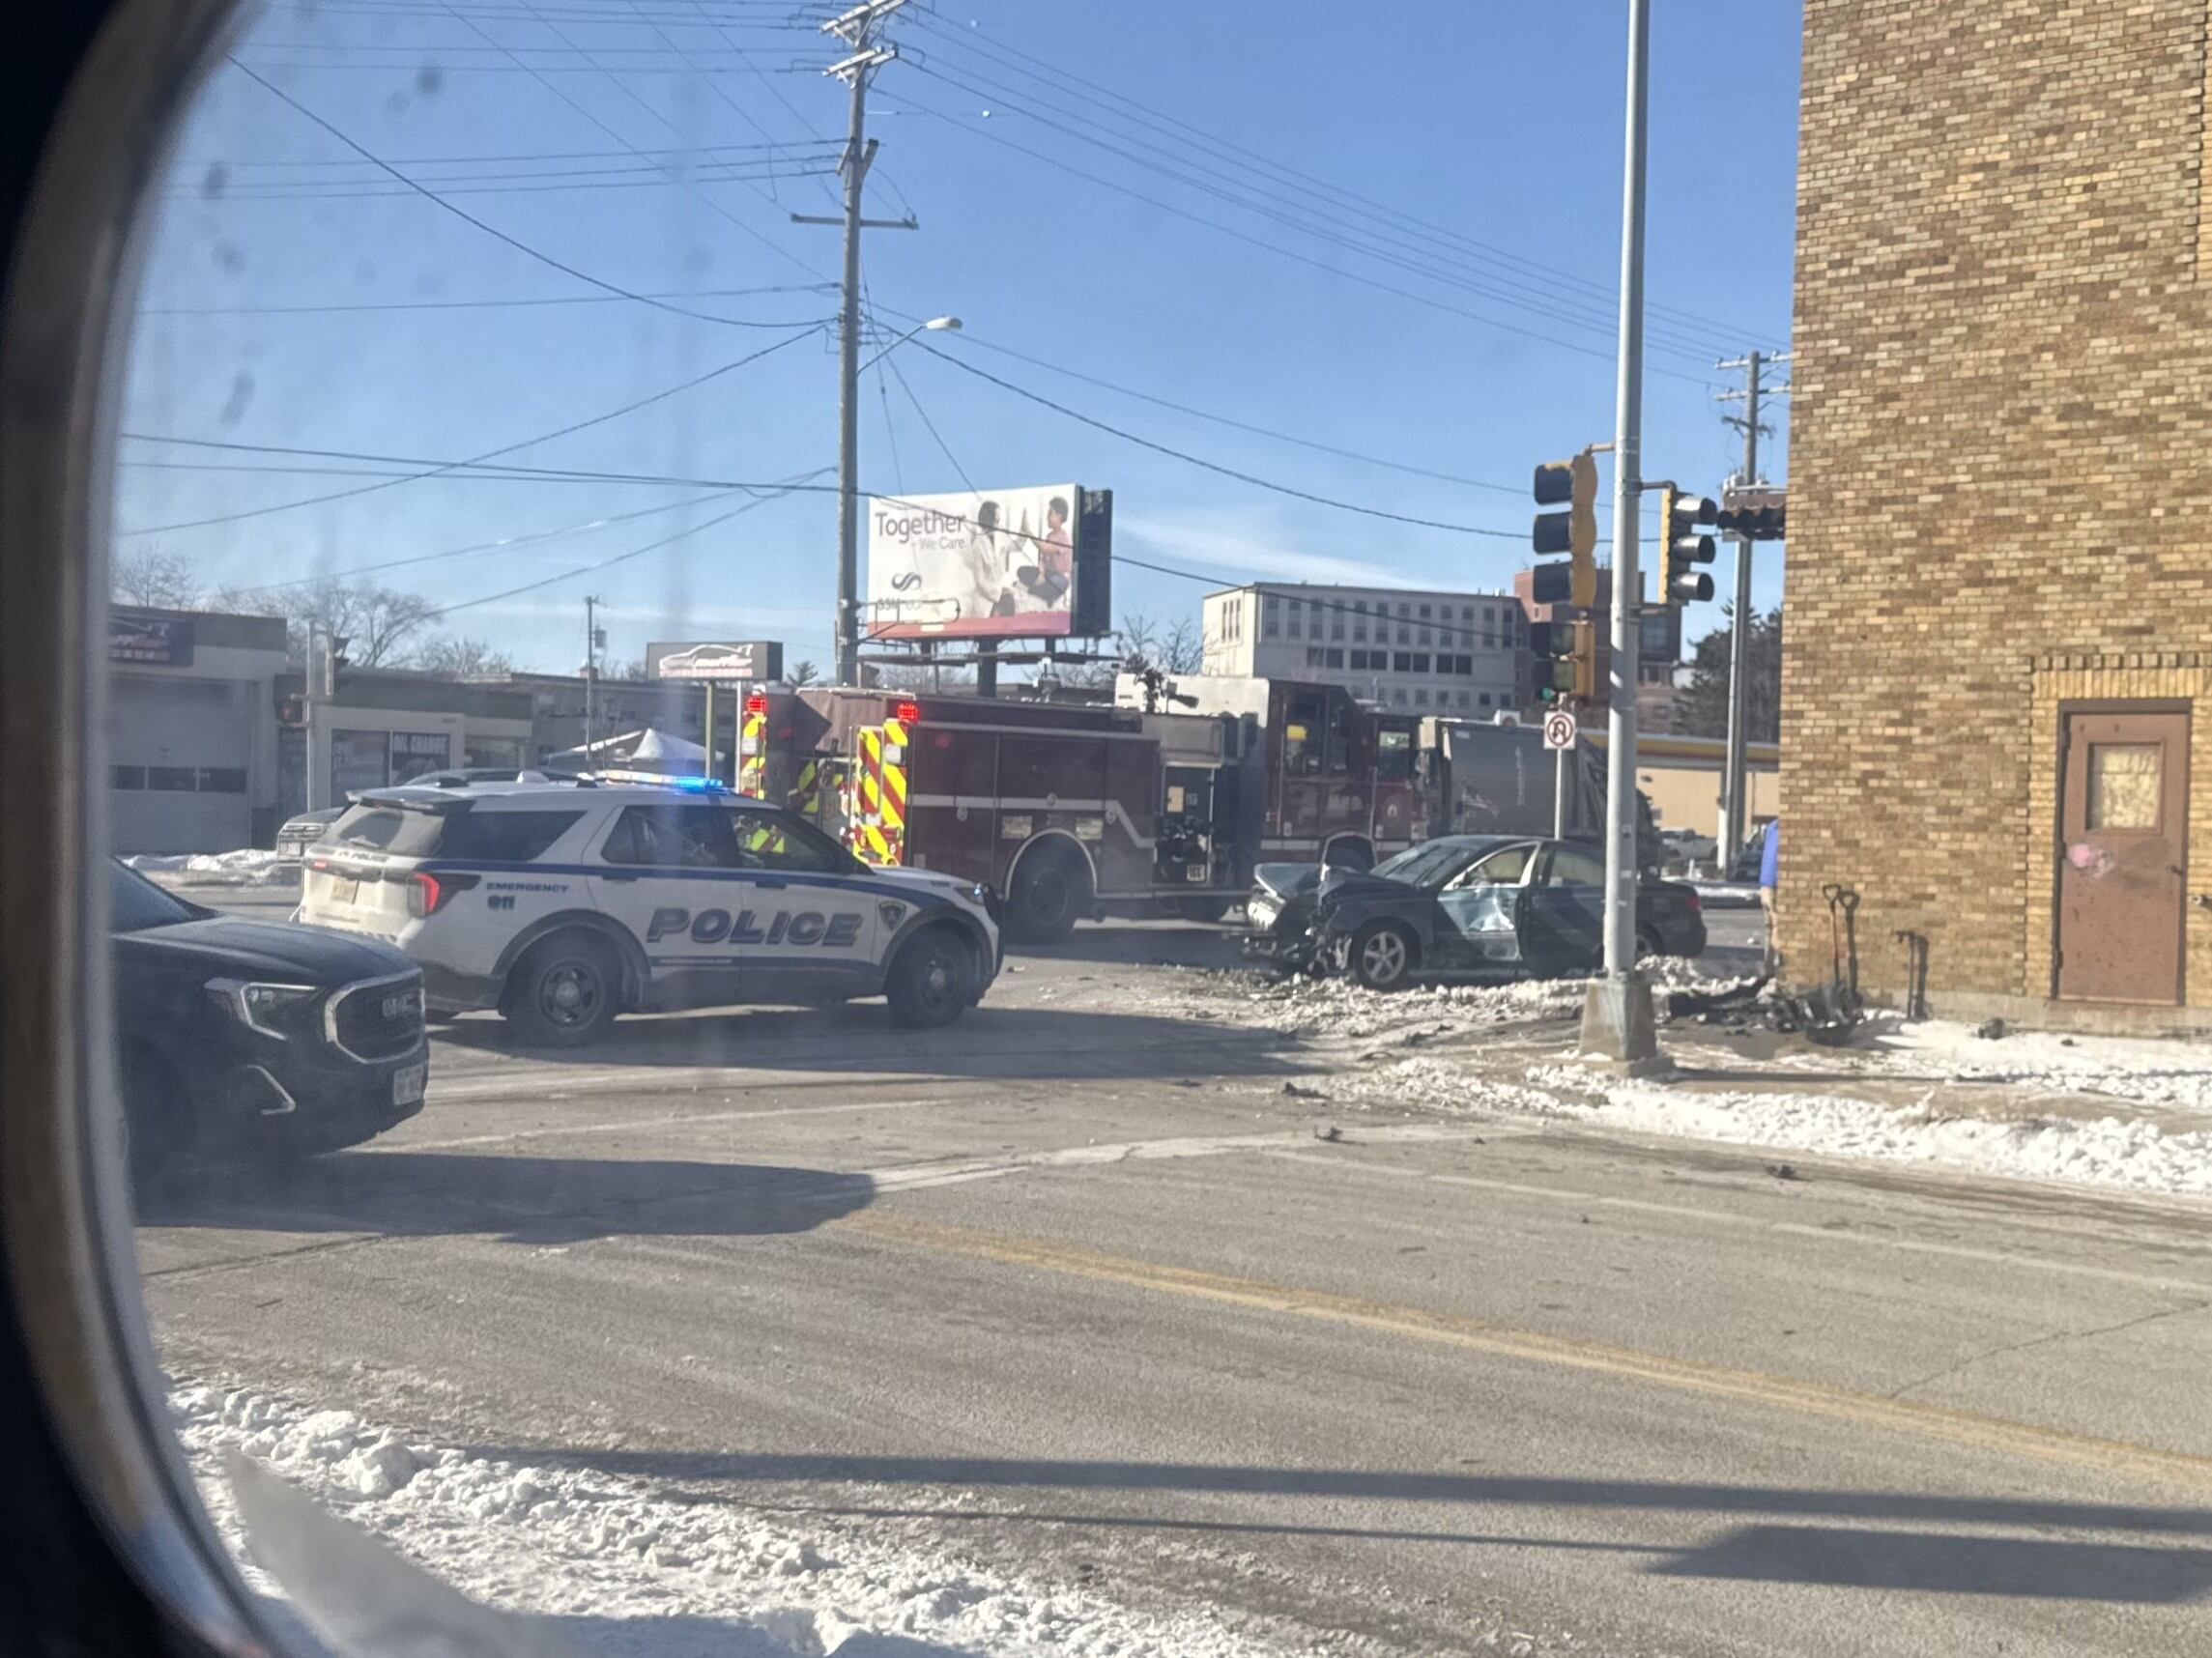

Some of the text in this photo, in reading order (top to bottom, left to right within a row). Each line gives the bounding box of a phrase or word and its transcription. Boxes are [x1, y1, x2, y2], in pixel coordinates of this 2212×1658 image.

[875, 510, 965, 544] Together
[939, 536, 964, 550] Care
[486, 882, 569, 893] EMERGENCY
[487, 896, 516, 910] 911
[646, 907, 864, 947] POLICE
